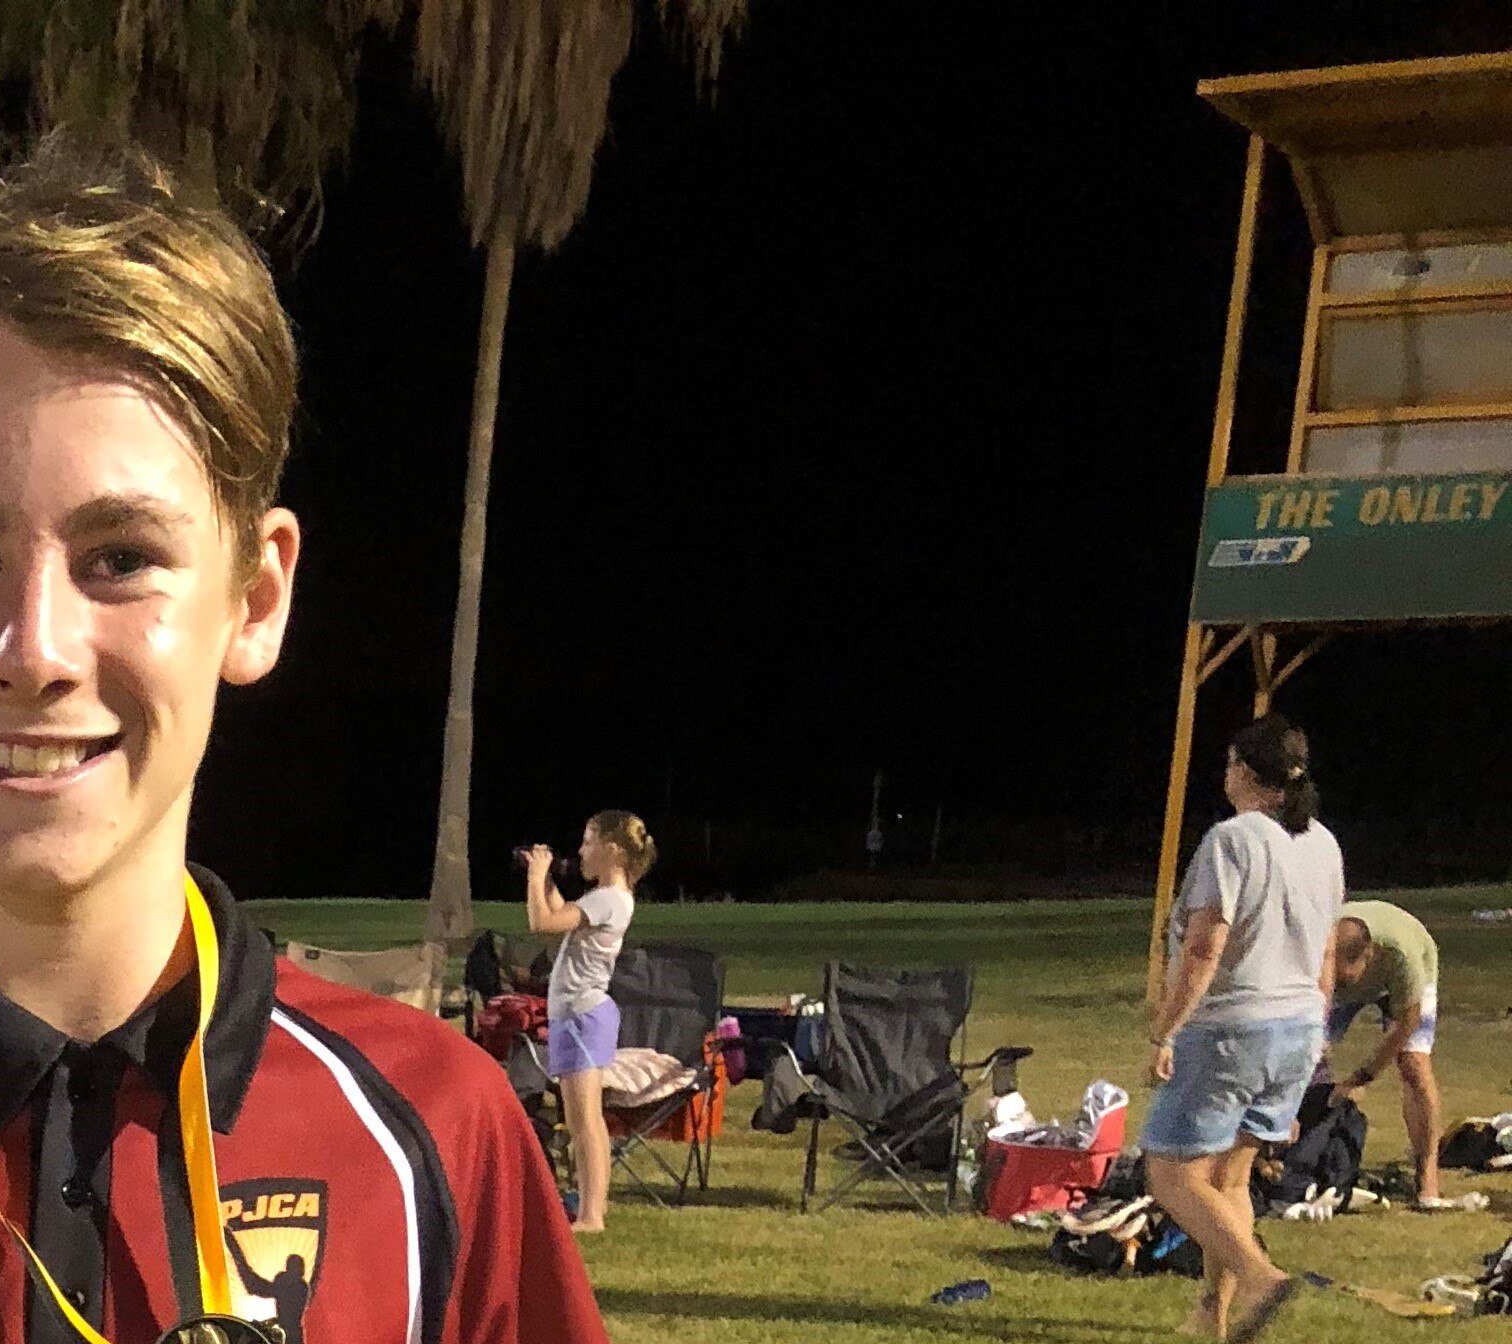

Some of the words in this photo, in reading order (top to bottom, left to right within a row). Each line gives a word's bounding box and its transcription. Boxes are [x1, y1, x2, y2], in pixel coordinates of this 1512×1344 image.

[1256, 489, 1338, 530] THE
[1359, 480, 1509, 525] ONLEY
[219, 1192, 320, 1227] PJCA
